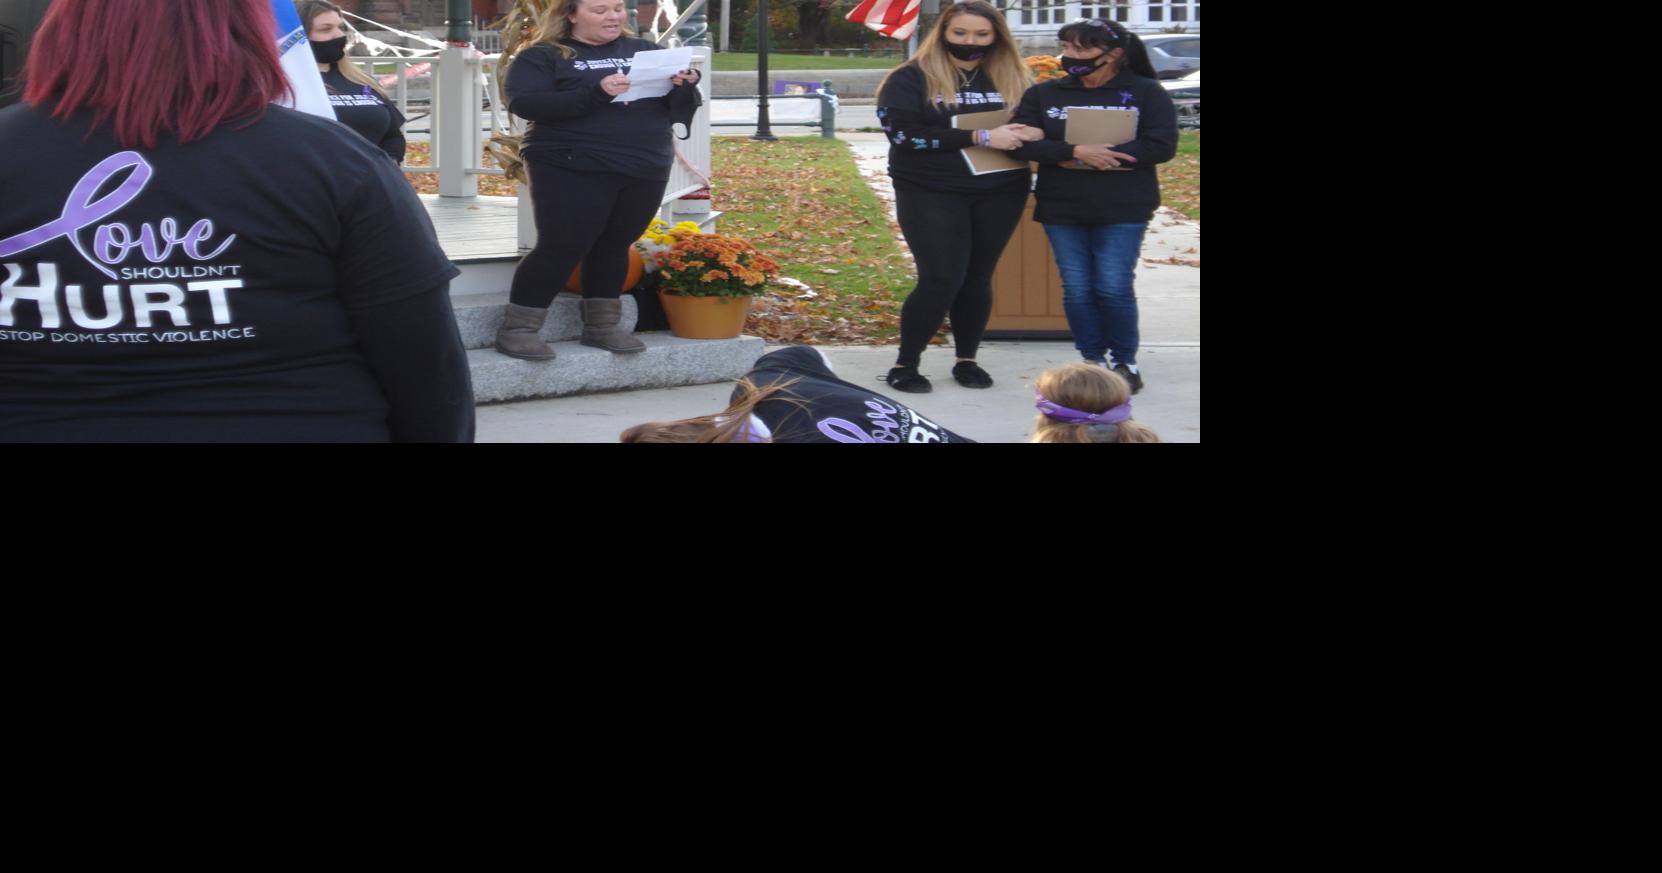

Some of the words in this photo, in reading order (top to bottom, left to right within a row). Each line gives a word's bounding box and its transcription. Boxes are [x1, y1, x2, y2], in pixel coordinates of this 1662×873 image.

[120, 265, 242, 280] SHOULDN'T
[0, 262, 244, 330] HURT
[0, 329, 46, 342] STOP
[50, 331, 150, 343] DOMESTIC
[152, 327, 256, 342] VIOLENCE
[907, 408, 941, 443] RT
